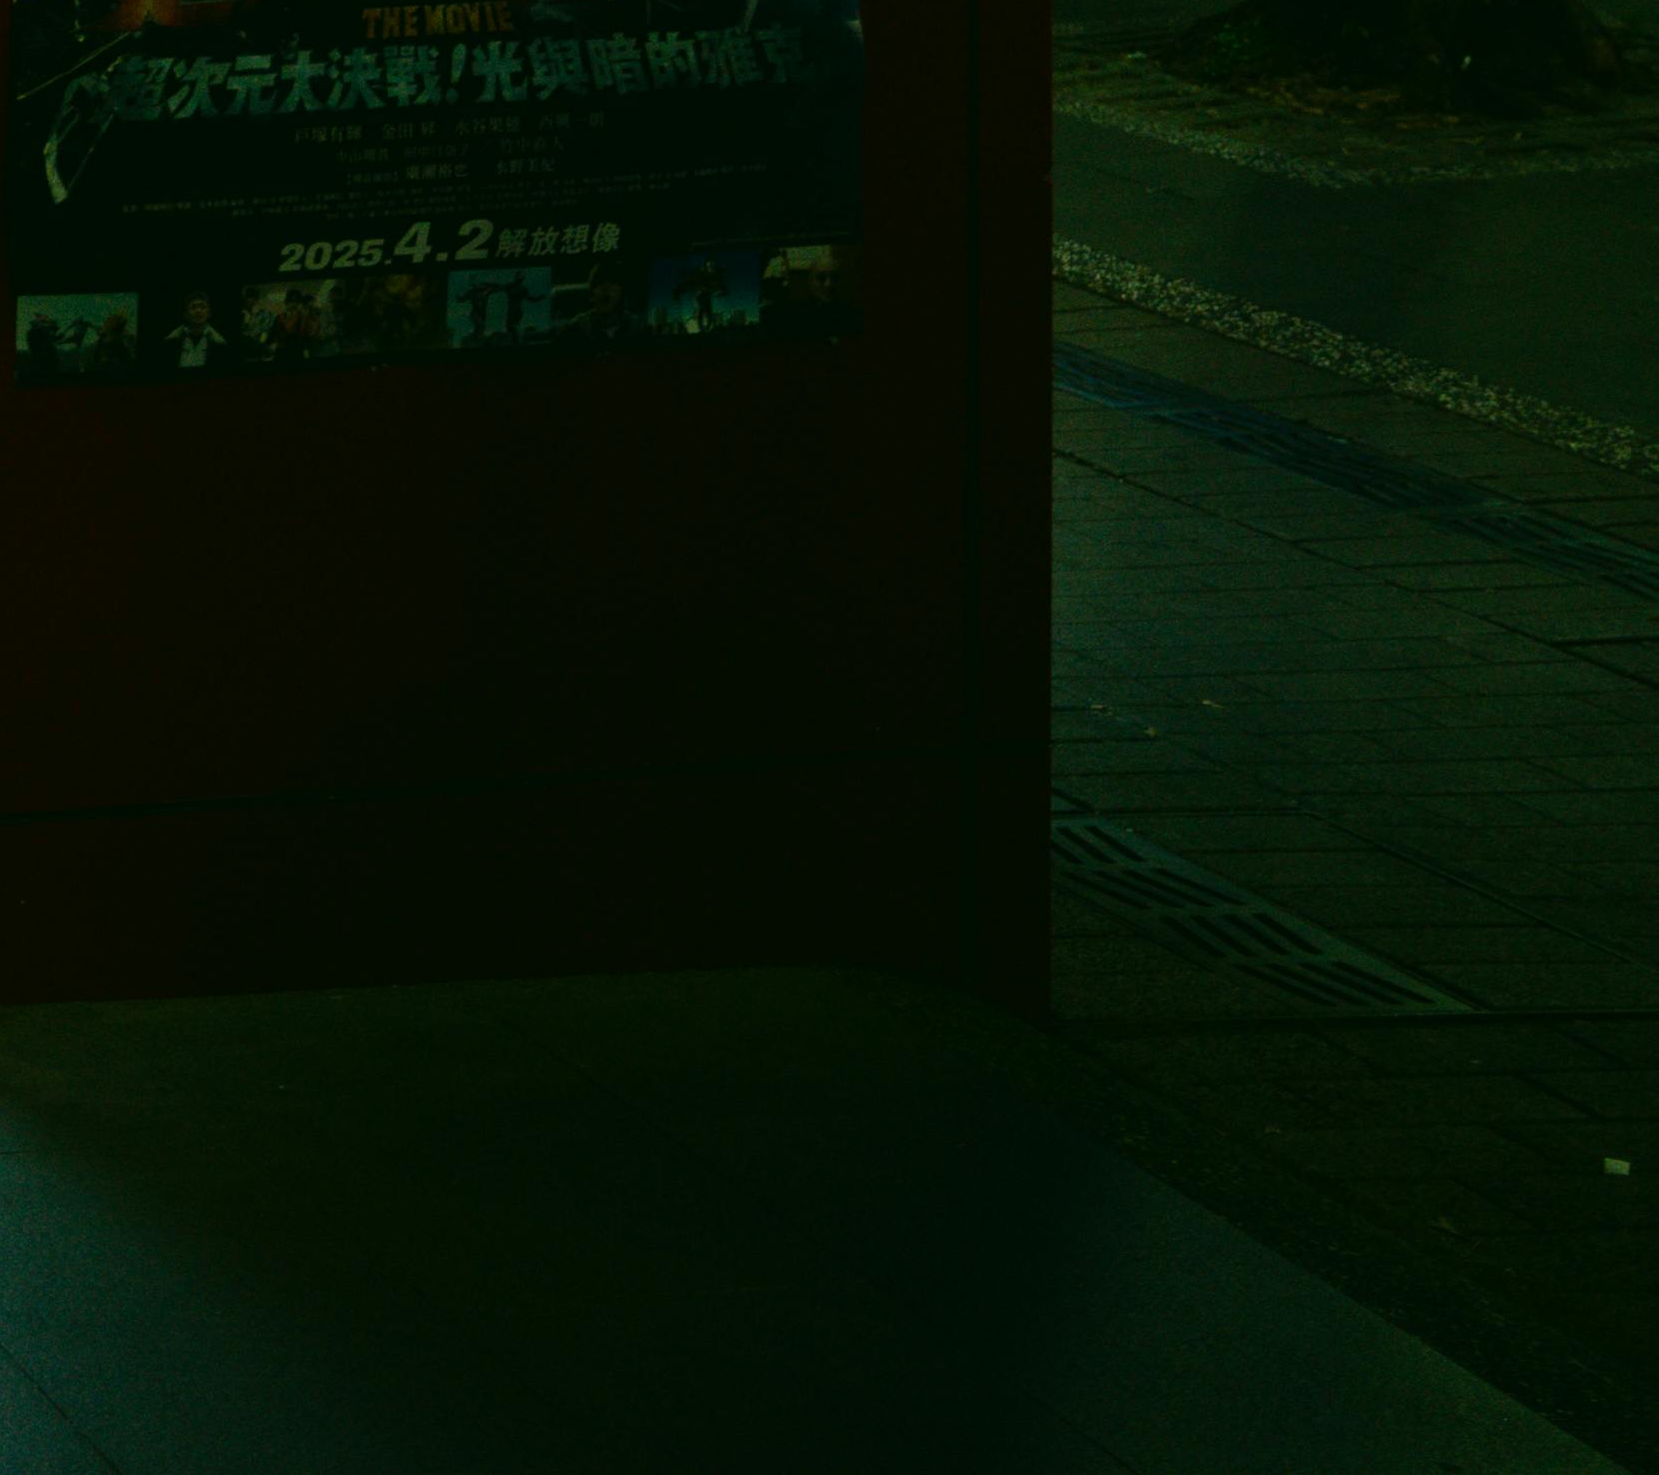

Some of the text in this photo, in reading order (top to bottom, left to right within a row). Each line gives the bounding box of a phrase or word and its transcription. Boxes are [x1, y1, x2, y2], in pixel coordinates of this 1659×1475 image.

[362, 1, 515, 41] THE MOVIE
[279, 217, 622, 274] 2025.4.2 解放想像
